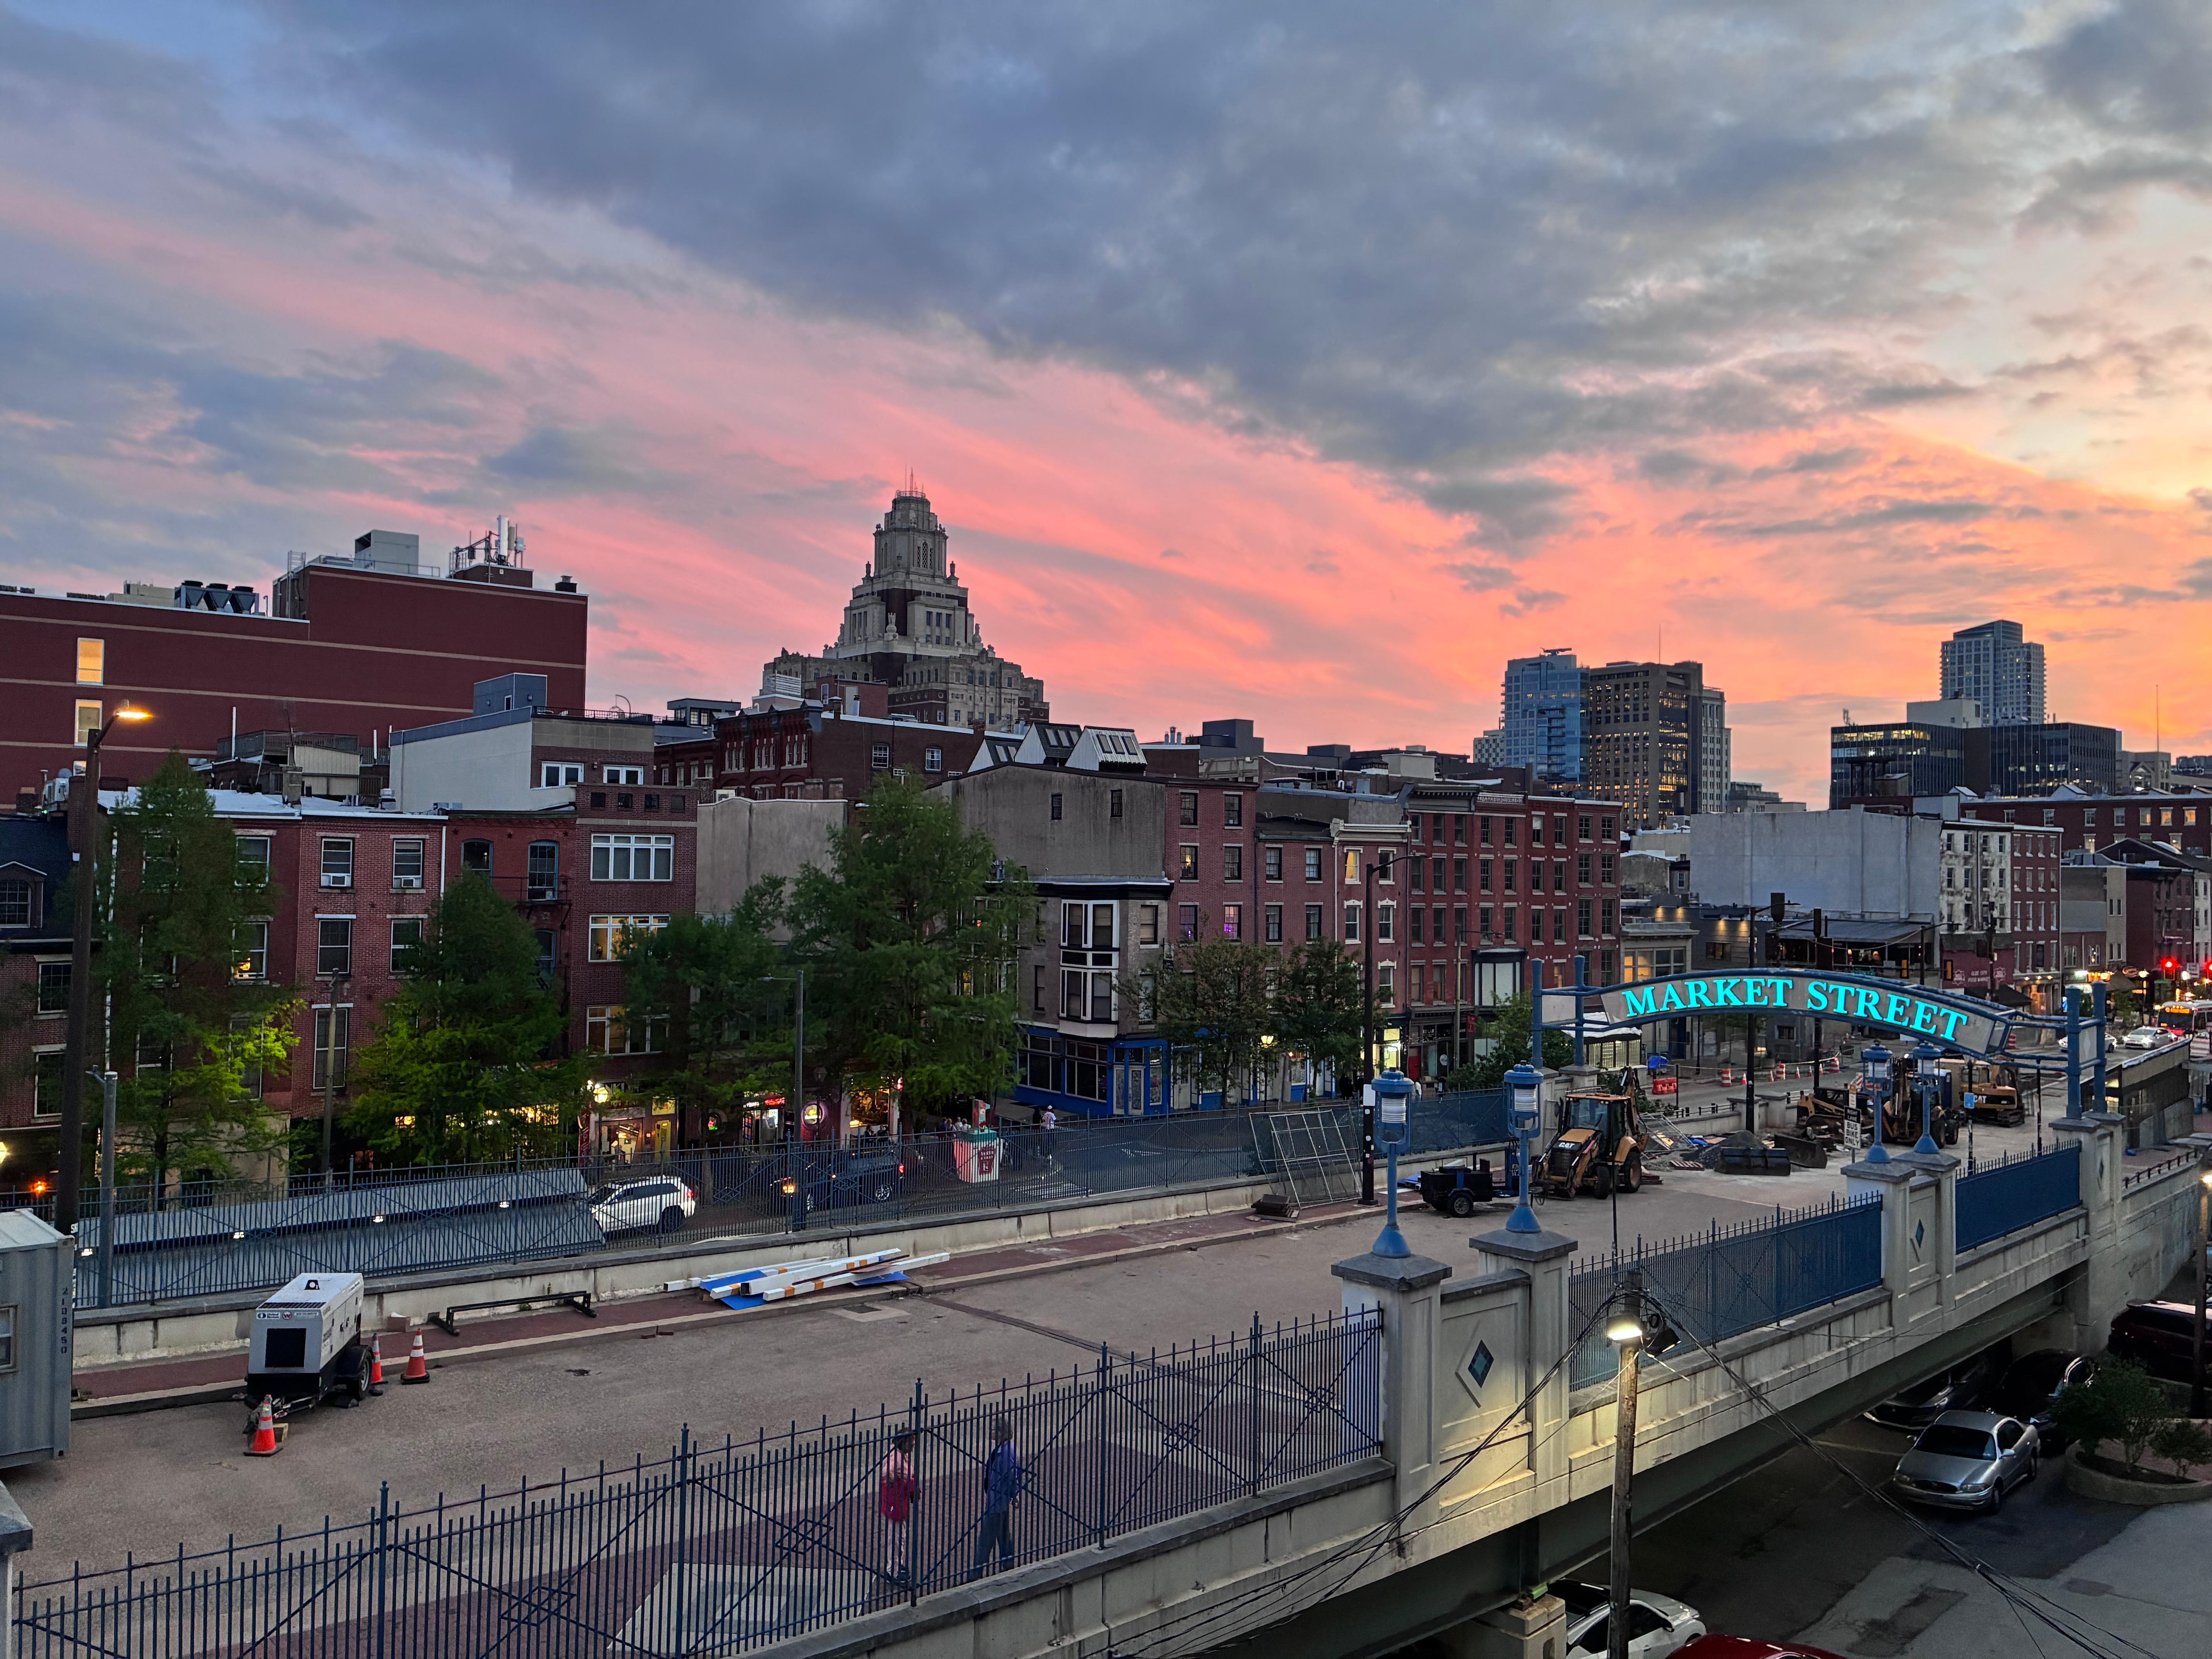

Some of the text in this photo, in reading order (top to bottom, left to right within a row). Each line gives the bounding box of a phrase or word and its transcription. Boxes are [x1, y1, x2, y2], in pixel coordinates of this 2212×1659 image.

[1622, 978, 1968, 1041] MARKET STREET
[1974, 1095, 1987, 1103] CAT
[1847, 1122, 1858, 1130] BUS
[1846, 1129, 1859, 1139] BIKE
[1845, 1137, 1859, 1146] ONLY
